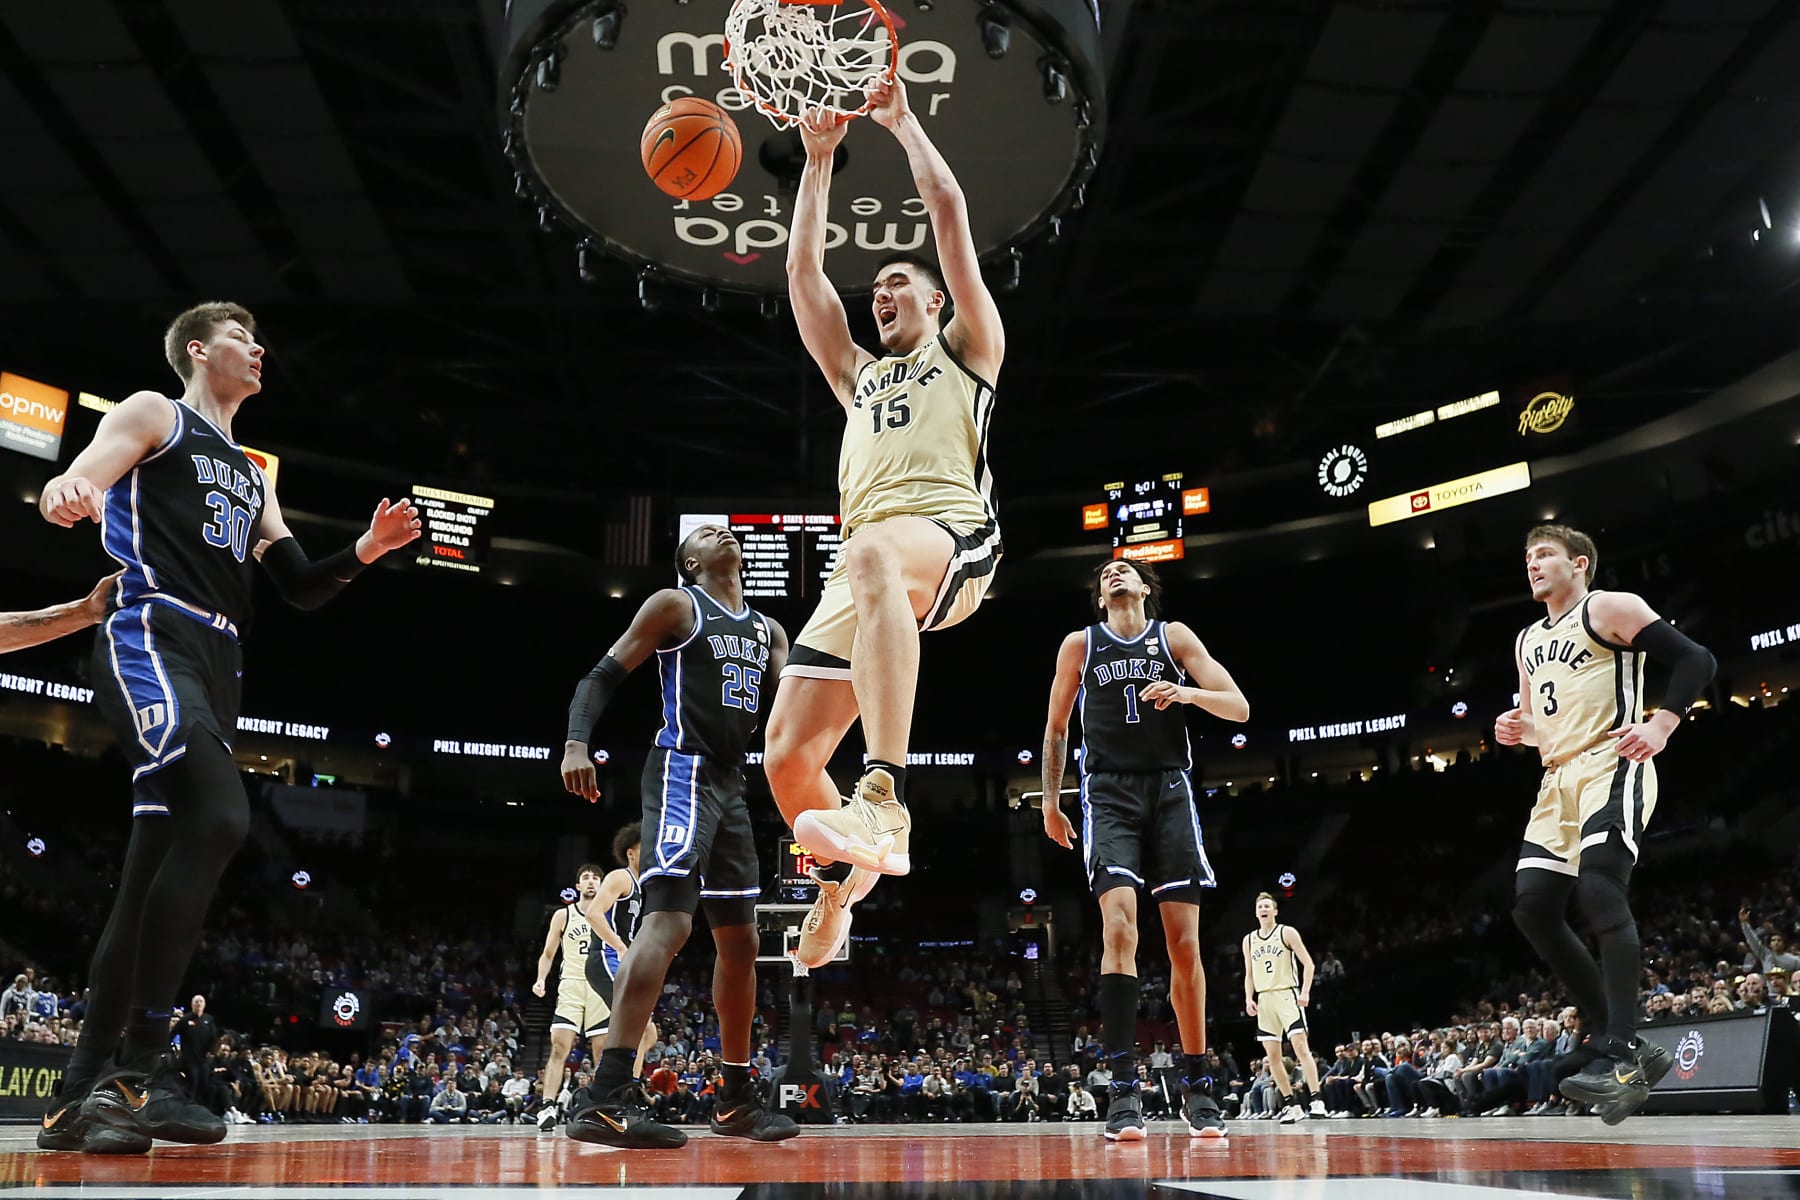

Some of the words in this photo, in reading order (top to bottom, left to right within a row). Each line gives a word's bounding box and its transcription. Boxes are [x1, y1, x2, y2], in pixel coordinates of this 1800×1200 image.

[661, 84, 951, 117] centr
[673, 193, 929, 217] ceter
[853, 360, 943, 410] PURDUE
[870, 391, 912, 436] 15
[190, 454, 262, 520] DUKE
[1435, 482, 1484, 502] TOYOTA
[202, 490, 253, 564] 30
[431, 532, 470, 547] STEALS
[432, 545, 465, 560] TOTAL
[707, 634, 770, 672] DUKE
[1750, 628, 1785, 651] PHIL
[1524, 639, 1593, 676] URDUE
[1094, 658, 1165, 687] DUKE
[0, 673, 45, 695] NIGHT
[46, 681, 95, 703] LEGACY
[721, 662, 762, 714] 25
[1539, 680, 1558, 717] 3
[137, 702, 165, 734] D
[1123, 684, 1140, 724] 1
[236, 716, 283, 735] KNIGHT
[285, 722, 330, 740] LEGACY
[1288, 727, 1317, 742] PHIL
[1318, 721, 1363, 739] KNIGHT
[1365, 713, 1406, 733] LEGACY
[433, 739, 461, 754] PHIL
[463, 741, 507, 757] KNIGHT
[508, 745, 551, 760] LEGACY
[906, 753, 933, 765] IGHT
[934, 753, 975, 765] LEGACY
[663, 824, 686, 844] D
[578, 939, 590, 955] 2
[1252, 944, 1284, 962] PURDUE
[1264, 960, 1274, 974] 2
